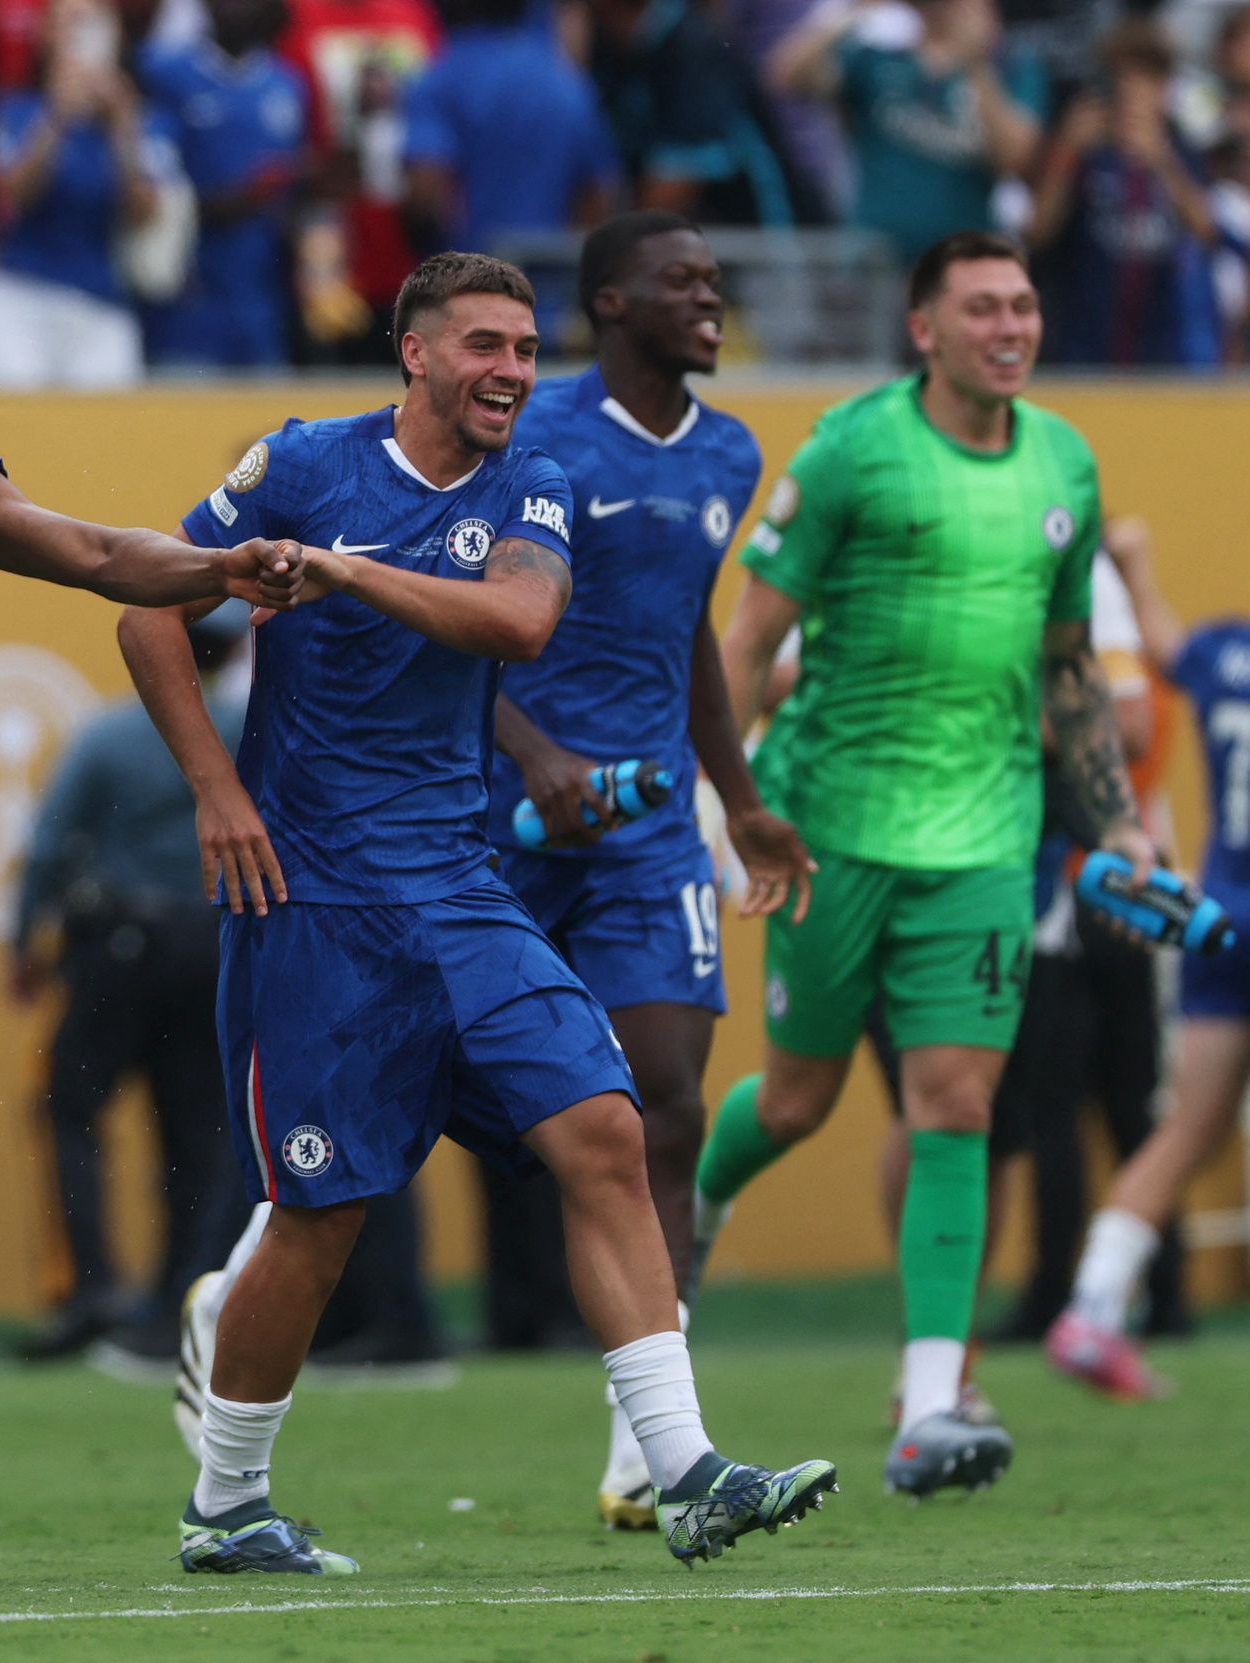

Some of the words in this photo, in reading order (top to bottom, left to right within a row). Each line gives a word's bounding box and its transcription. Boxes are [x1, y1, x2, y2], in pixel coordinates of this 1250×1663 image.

[524, 497, 565, 520] LIVE
[454, 520, 488, 532] CHELSEA
[680, 881, 717, 956] 19
[290, 1127, 322, 1139] CHELSEA
